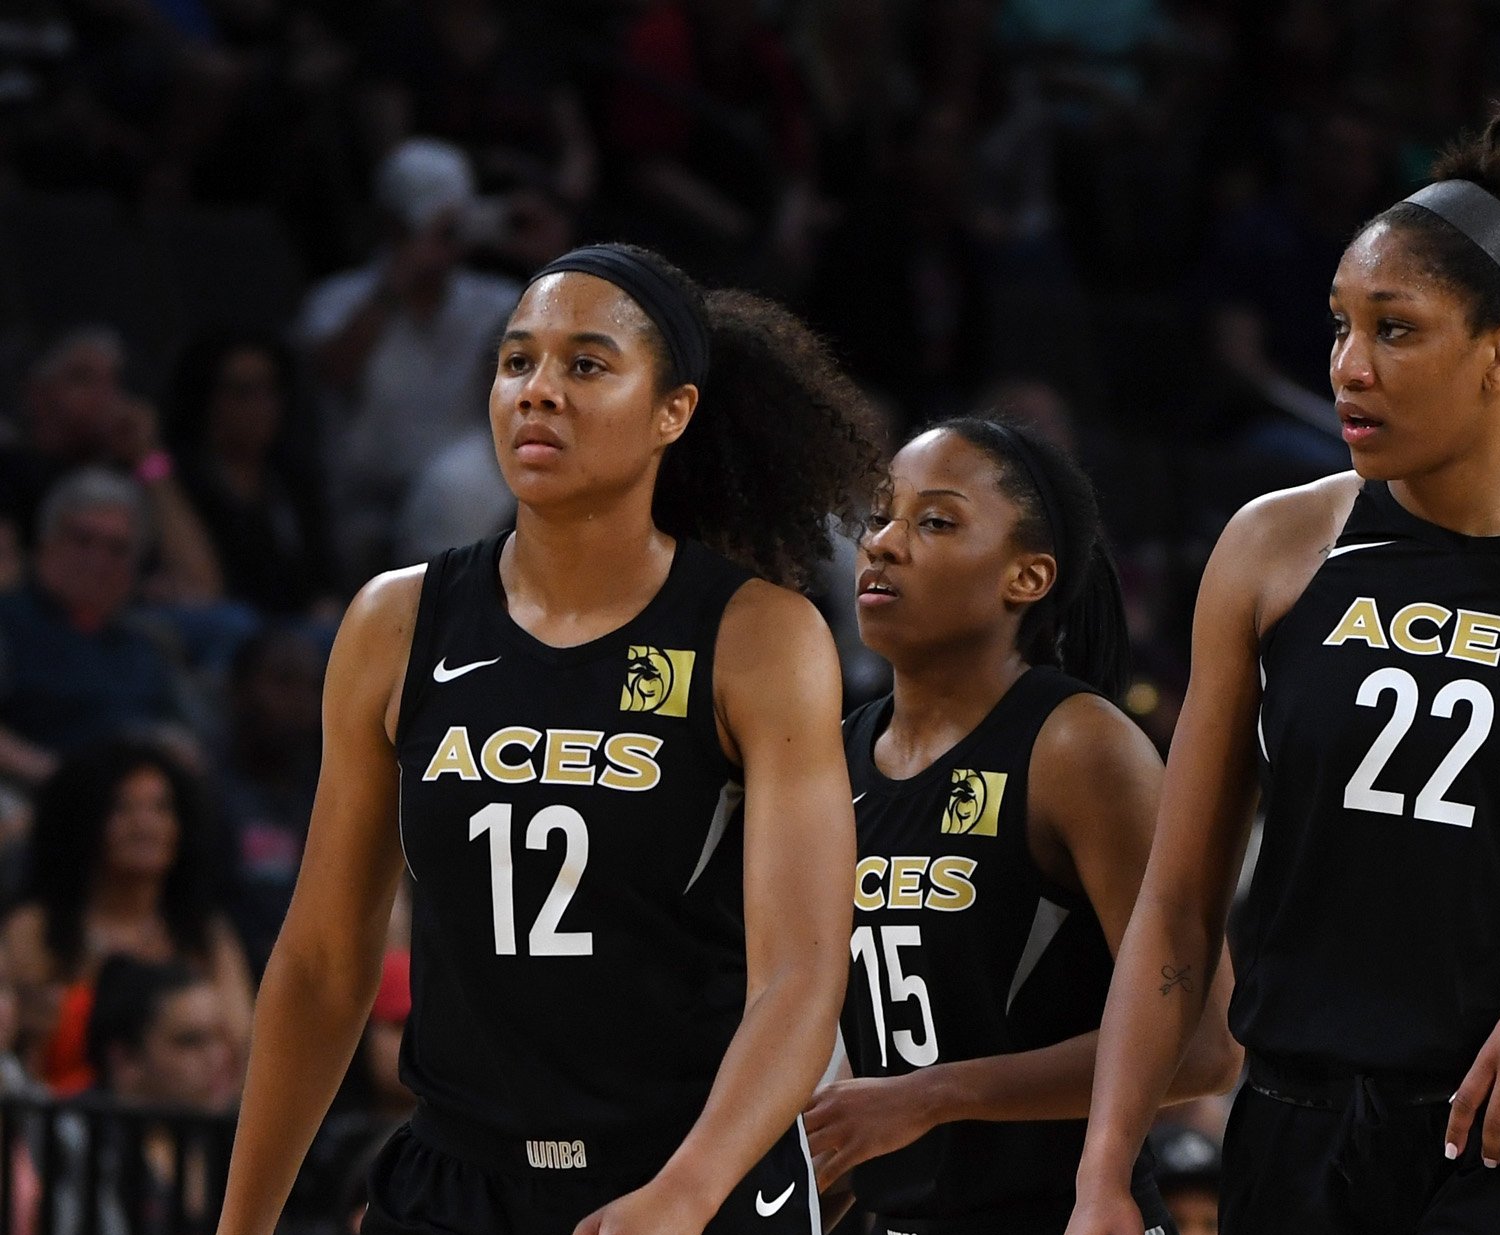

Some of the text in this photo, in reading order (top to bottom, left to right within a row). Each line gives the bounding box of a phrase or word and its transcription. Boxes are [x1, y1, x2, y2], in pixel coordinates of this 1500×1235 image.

[422, 726, 664, 792] ACES
[1343, 667, 1496, 829] 22
[468, 802, 594, 957] 12
[854, 856, 979, 912] CES
[850, 925, 939, 1068] 15
